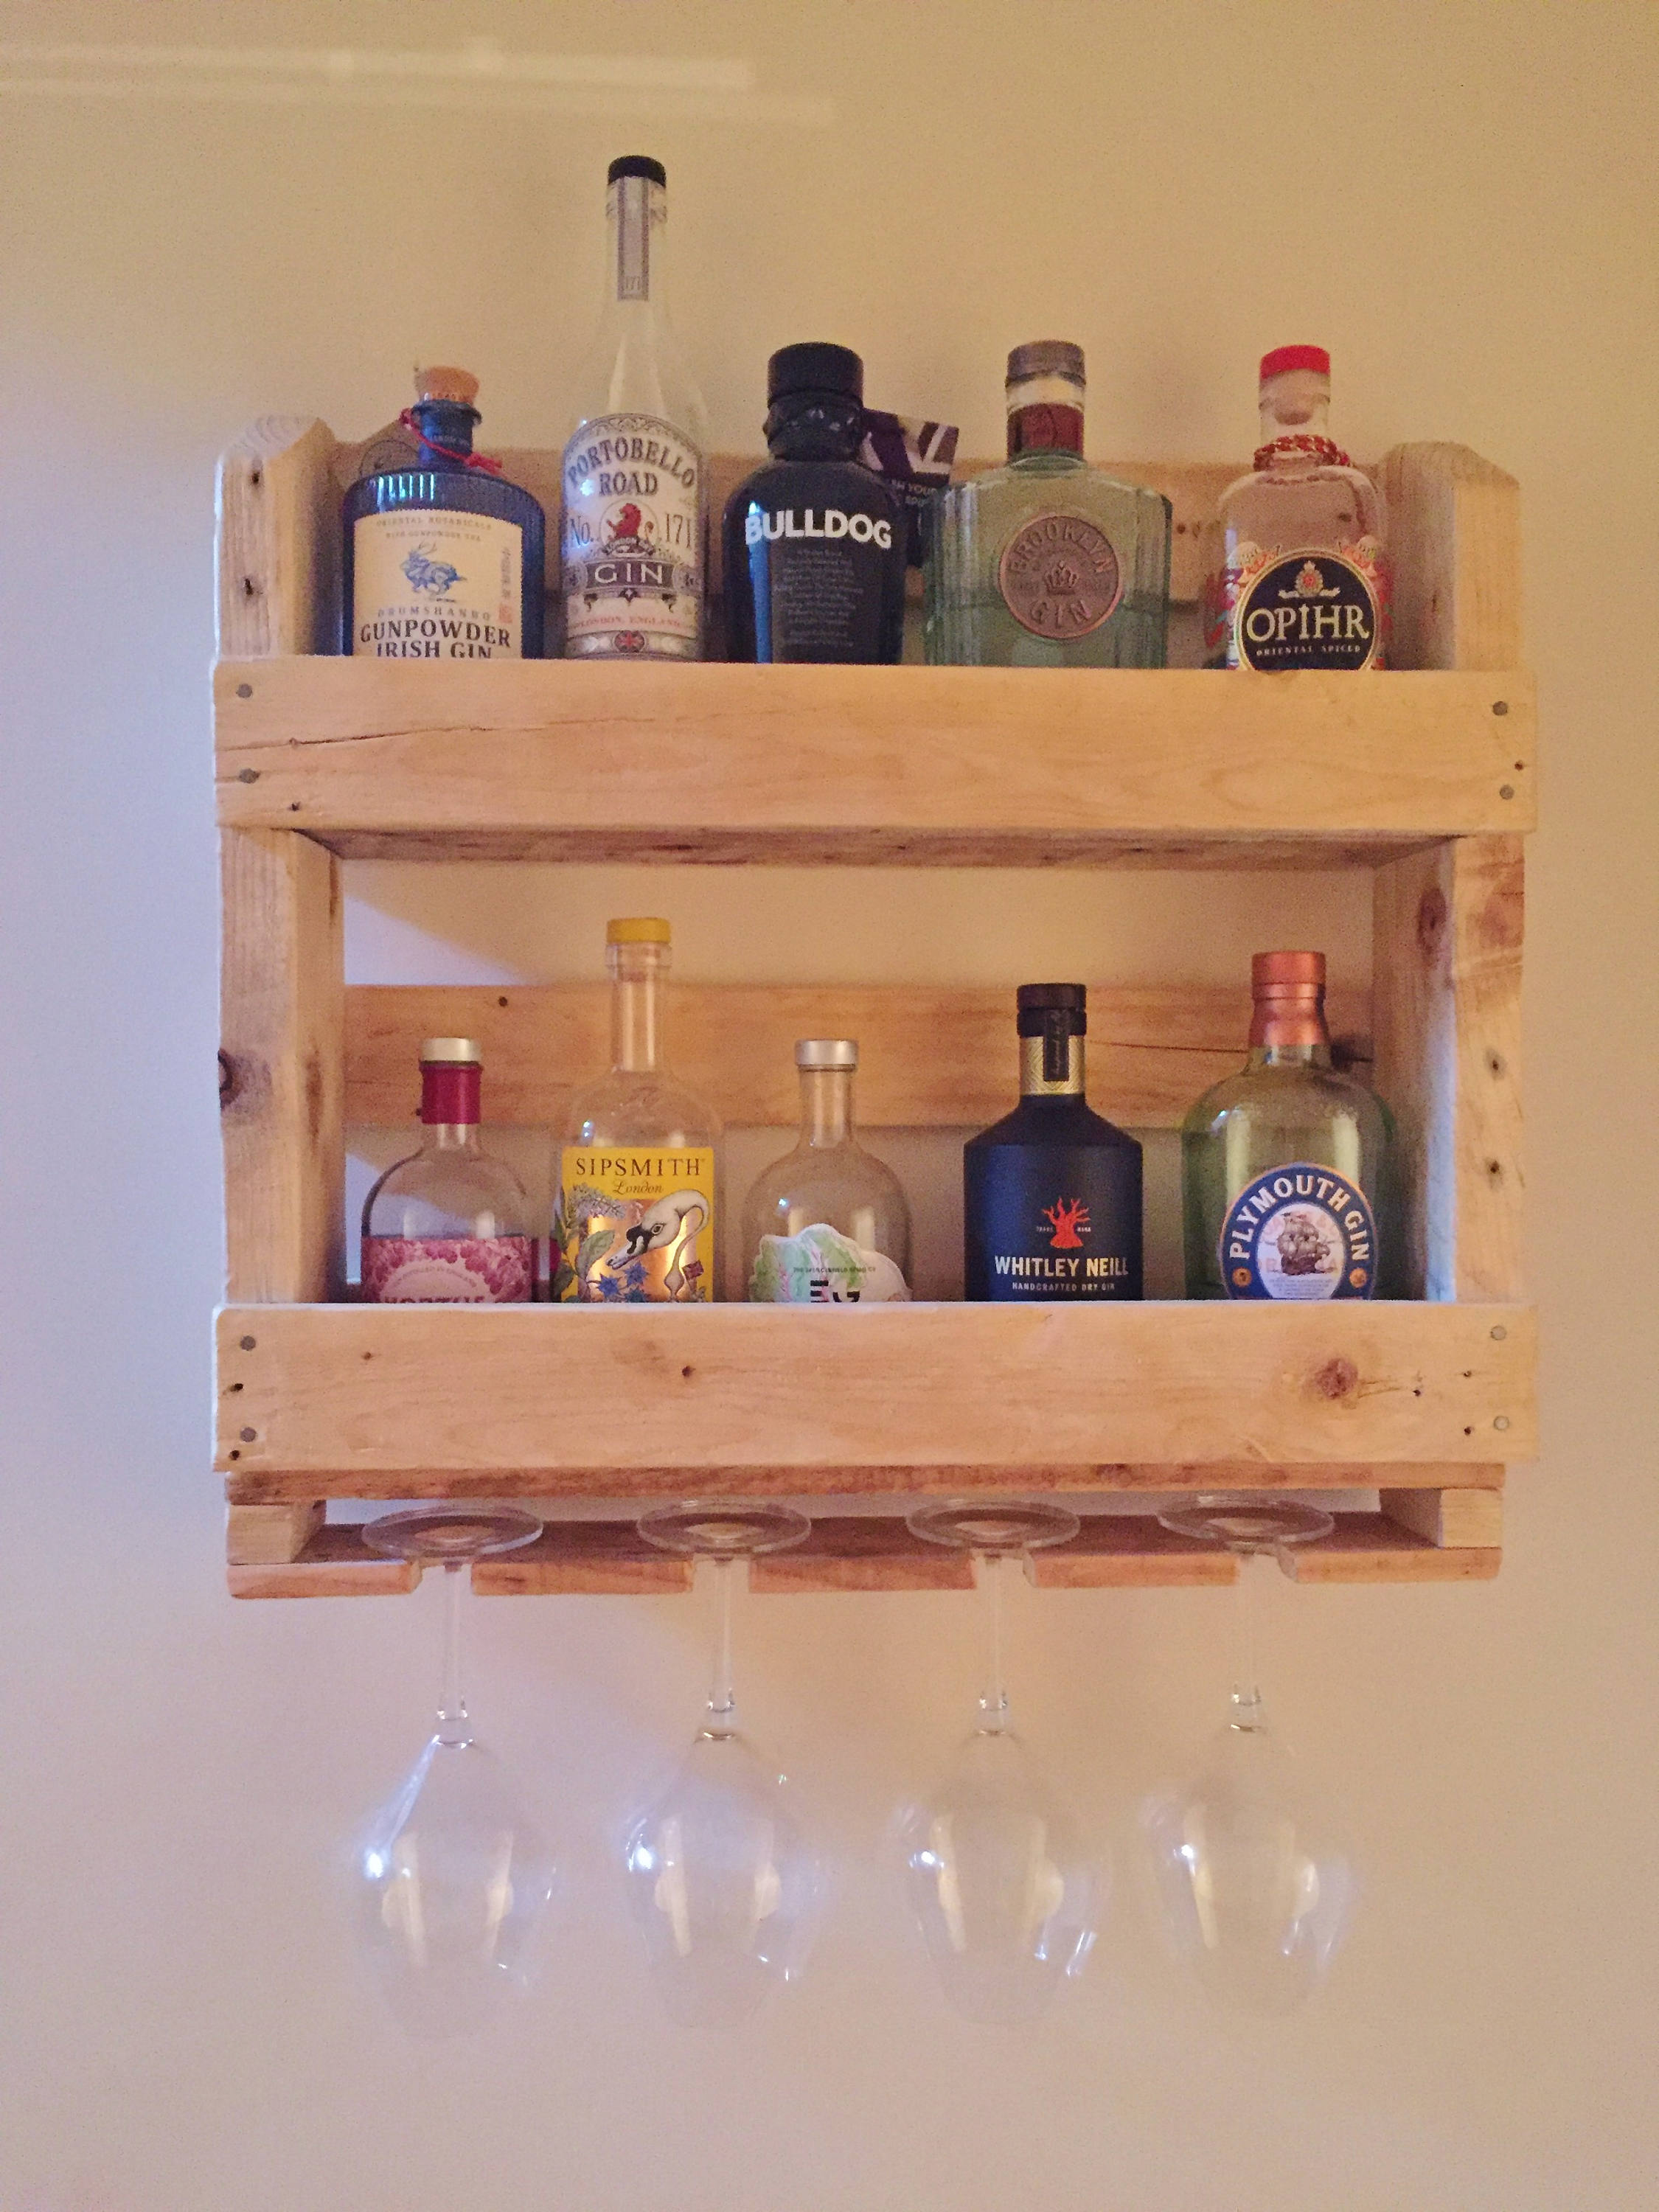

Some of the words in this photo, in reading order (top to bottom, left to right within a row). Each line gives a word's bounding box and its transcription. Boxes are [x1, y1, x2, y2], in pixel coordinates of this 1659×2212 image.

[567, 437, 695, 489] PORTOBELLO
[599, 472, 658, 496] ROAD
[666, 513, 692, 549] 171
[745, 509, 891, 549] BULLDOG
[1008, 522, 1113, 573] BROOKLYN
[594, 563, 664, 585] GIN
[378, 606, 491, 621] DRUMSHANBO
[1031, 599, 1092, 628] GIN
[1246, 603, 1370, 642] OPIHR
[360, 619, 511, 648] GUNPOWDER
[377, 639, 440, 658] IRISH
[450, 641, 492, 658] GIN
[1321, 644, 1360, 653] SPICED
[576, 1157, 701, 1177] SIPSMITH
[613, 1180, 663, 1195] London
[1229, 1175, 1352, 1260] PLYMOUTH
[1344, 1210, 1370, 1261] GIN
[995, 1256, 1079, 1277] WHITLEY
[1086, 1257, 1129, 1277] NEILL
[1012, 1282, 1077, 1292] HANDCRAFTED
[1081, 1283, 1098, 1291] DRY
[1101, 1283, 1115, 1291] GIN
